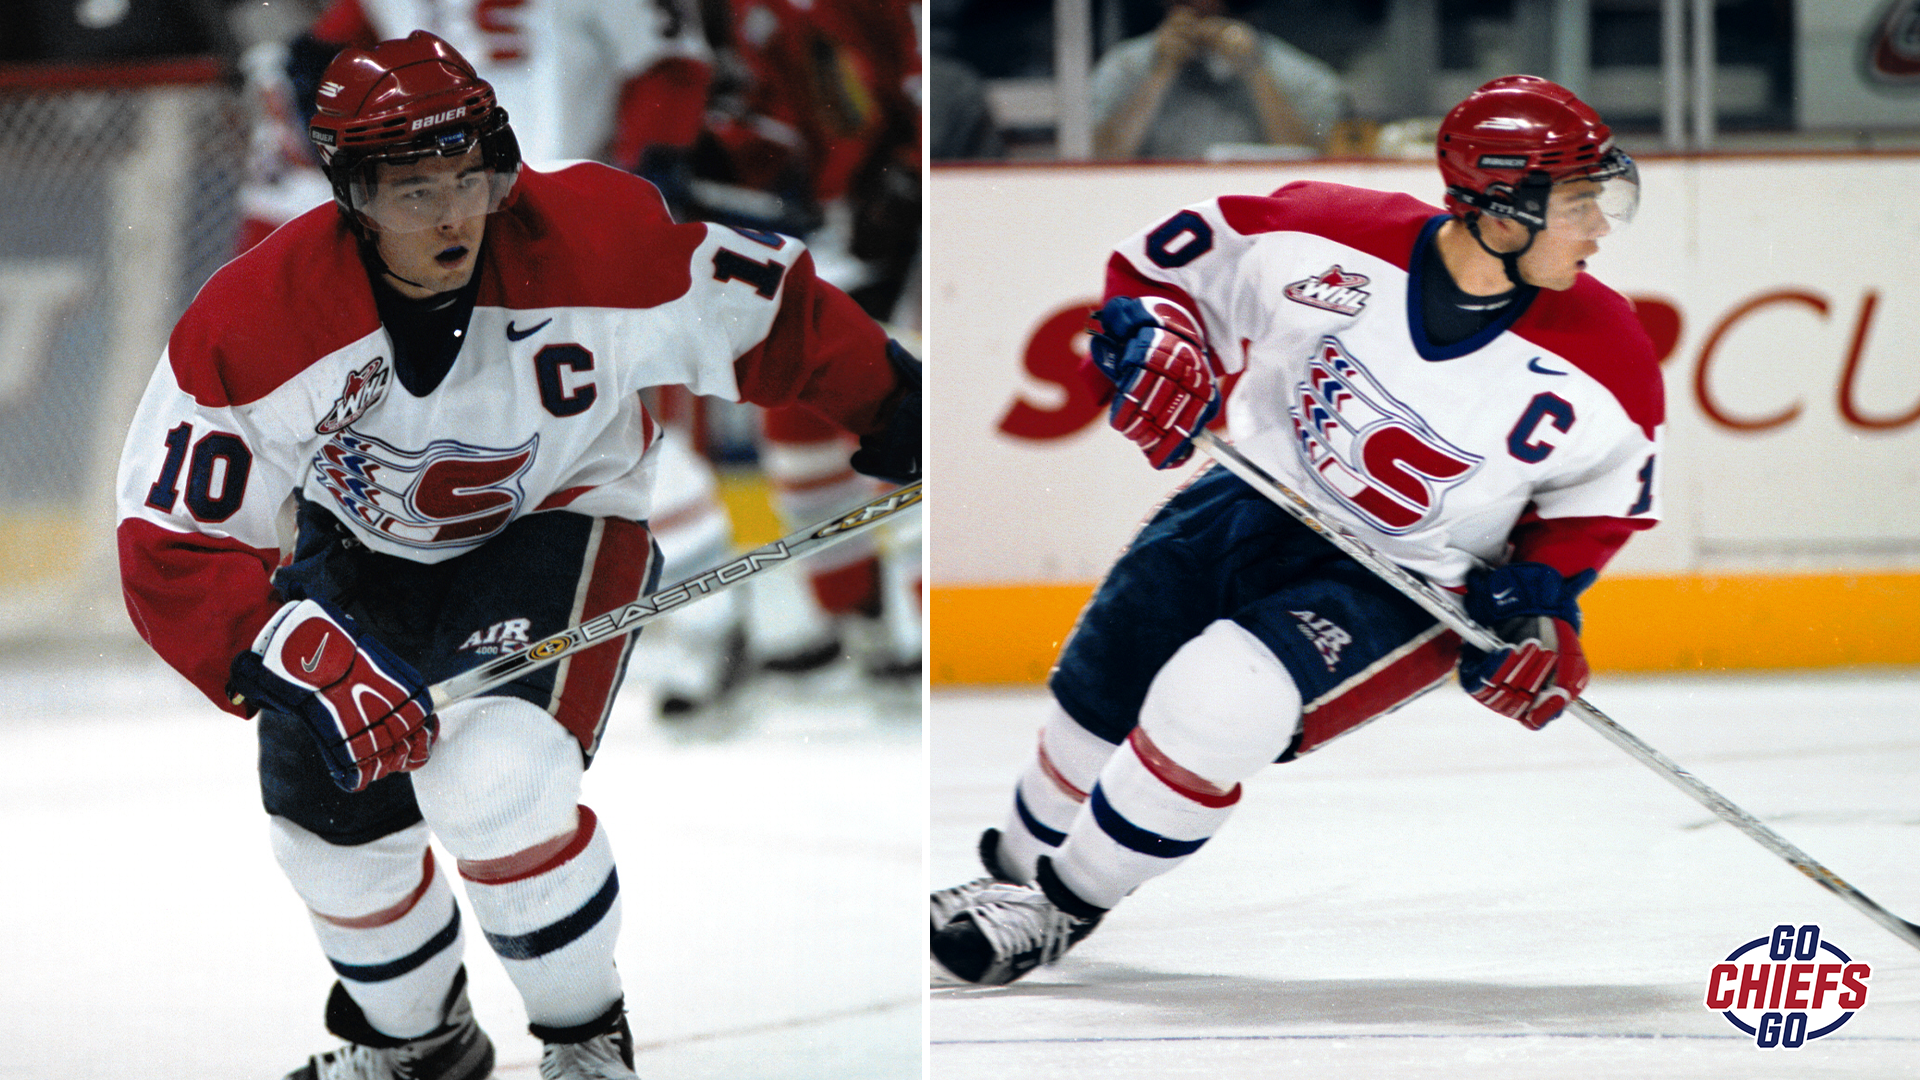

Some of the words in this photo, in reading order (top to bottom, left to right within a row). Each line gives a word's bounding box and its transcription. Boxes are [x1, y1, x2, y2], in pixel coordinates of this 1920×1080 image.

[411, 106, 467, 130] BAUER
[1303, 278, 1369, 310] WHL
[335, 366, 389, 424] WHL
[534, 343, 597, 418] C
[1506, 391, 1576, 464] C
[144, 420, 253, 523] 10
[581, 541, 791, 642] EASTON
[458, 617, 532, 651] AIR
[1286, 609, 1353, 652] AIR
